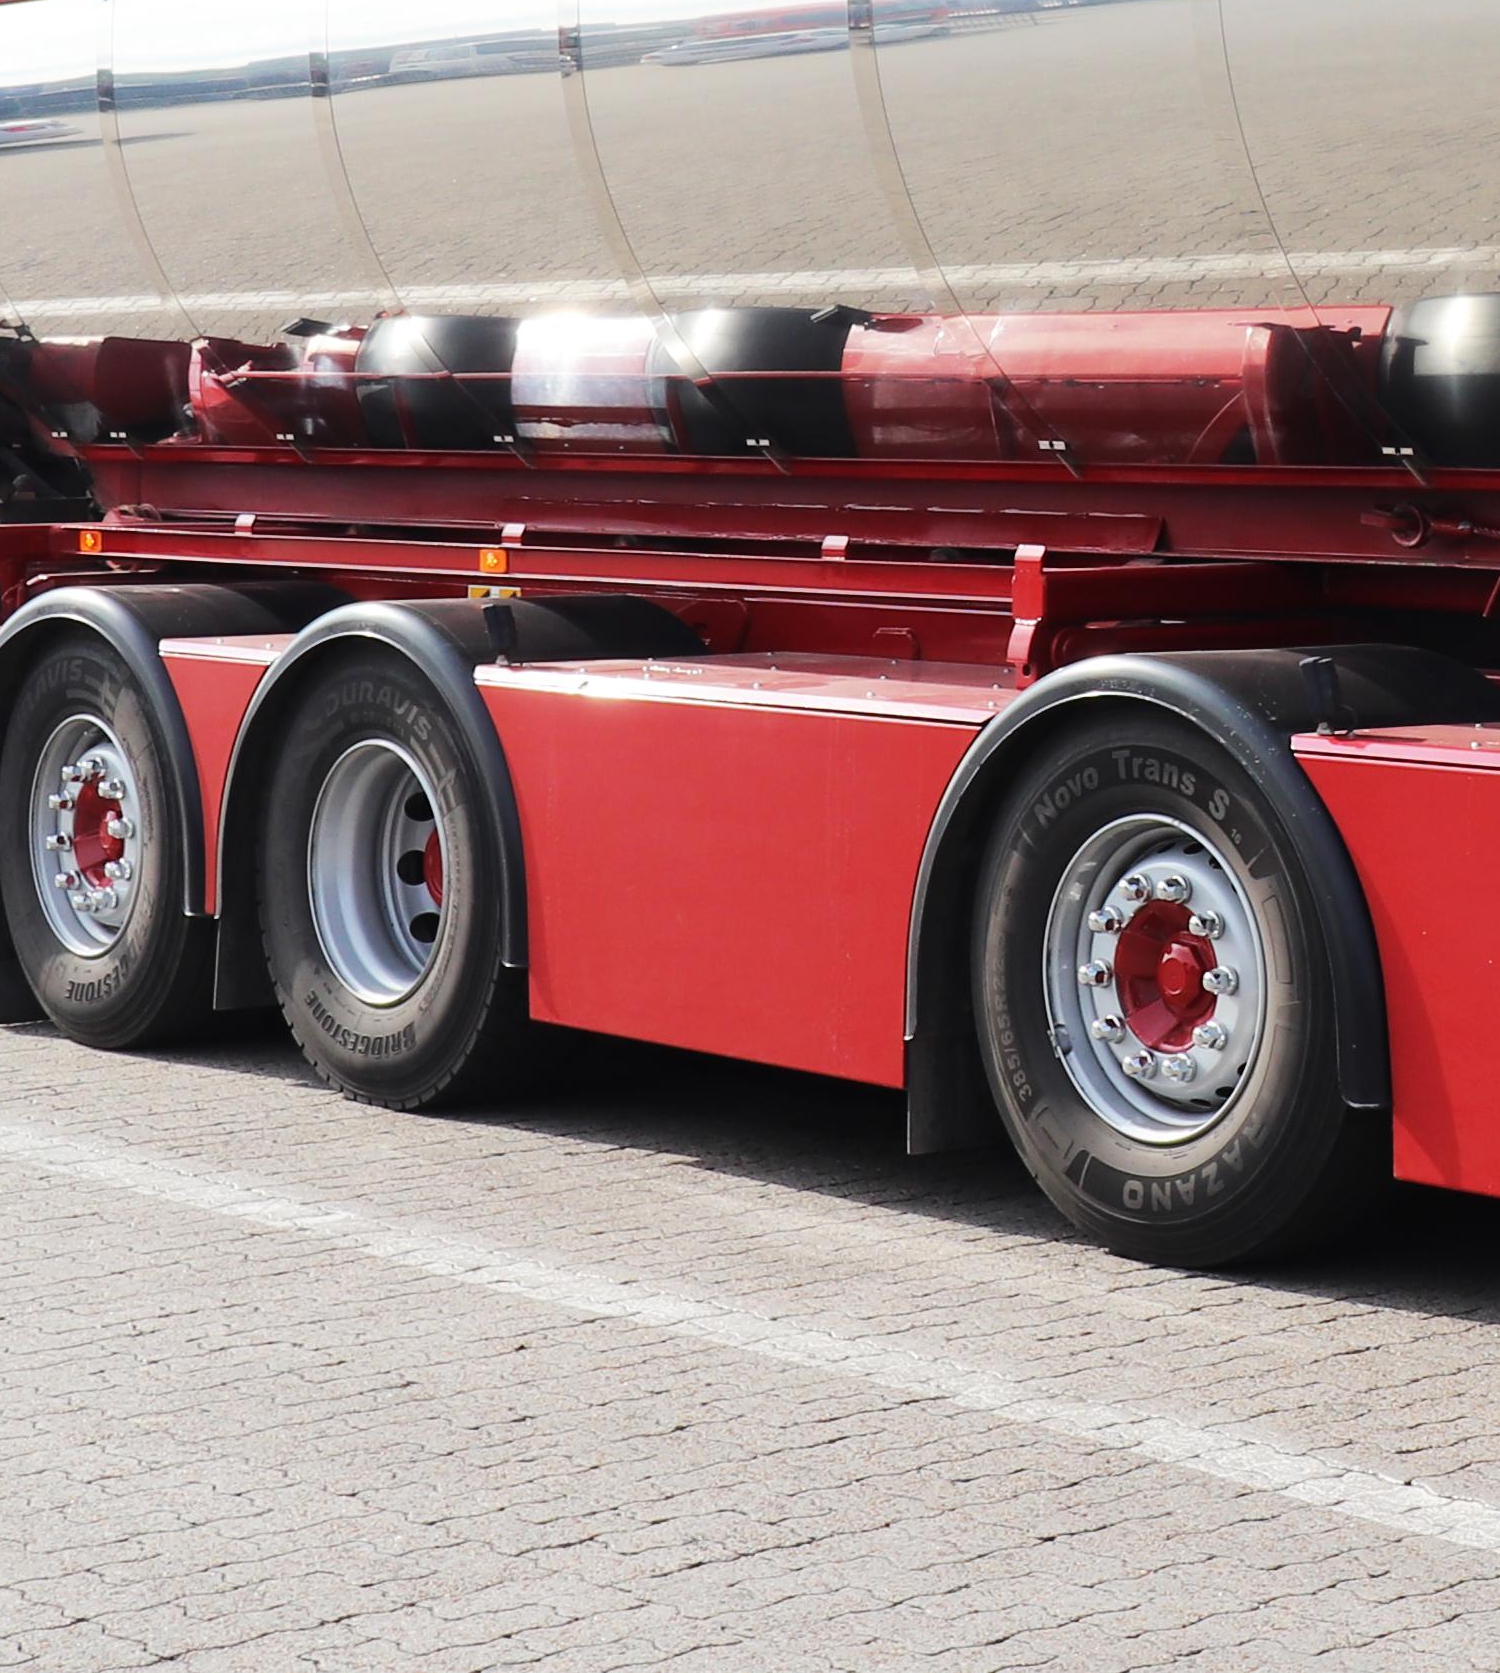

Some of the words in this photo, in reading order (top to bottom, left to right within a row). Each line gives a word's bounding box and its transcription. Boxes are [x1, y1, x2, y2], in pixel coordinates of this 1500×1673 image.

[324, 680, 432, 742] DURAVIS
[1034, 766, 1099, 824] Novo
[1112, 751, 1196, 797] Trans
[1208, 788, 1230, 821] S
[304, 988, 418, 1059] BRIDGESTONE
